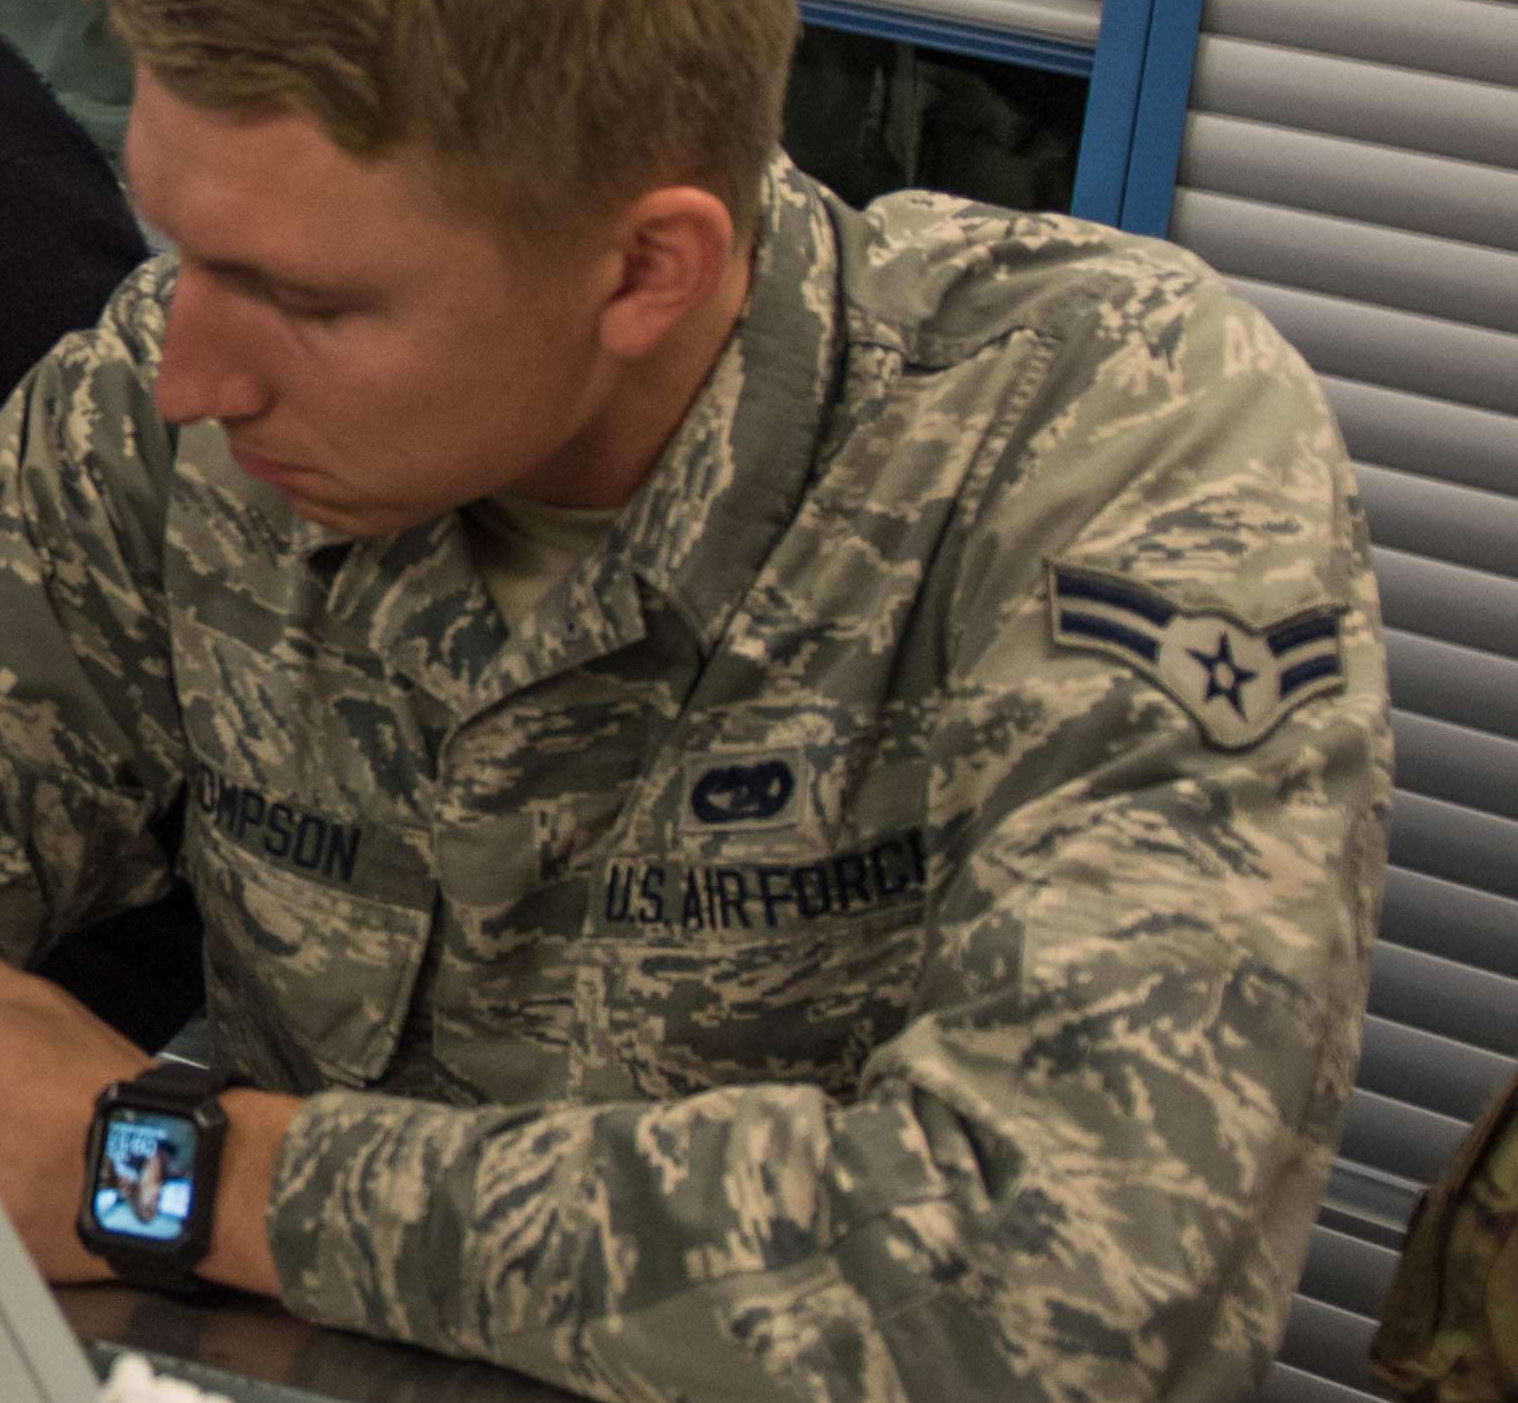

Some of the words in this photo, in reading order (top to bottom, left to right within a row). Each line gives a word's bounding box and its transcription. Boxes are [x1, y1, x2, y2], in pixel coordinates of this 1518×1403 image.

[196, 760, 363, 882] OMPSON
[605, 861, 671, 928] U.S.
[681, 864, 751, 930] AIR
